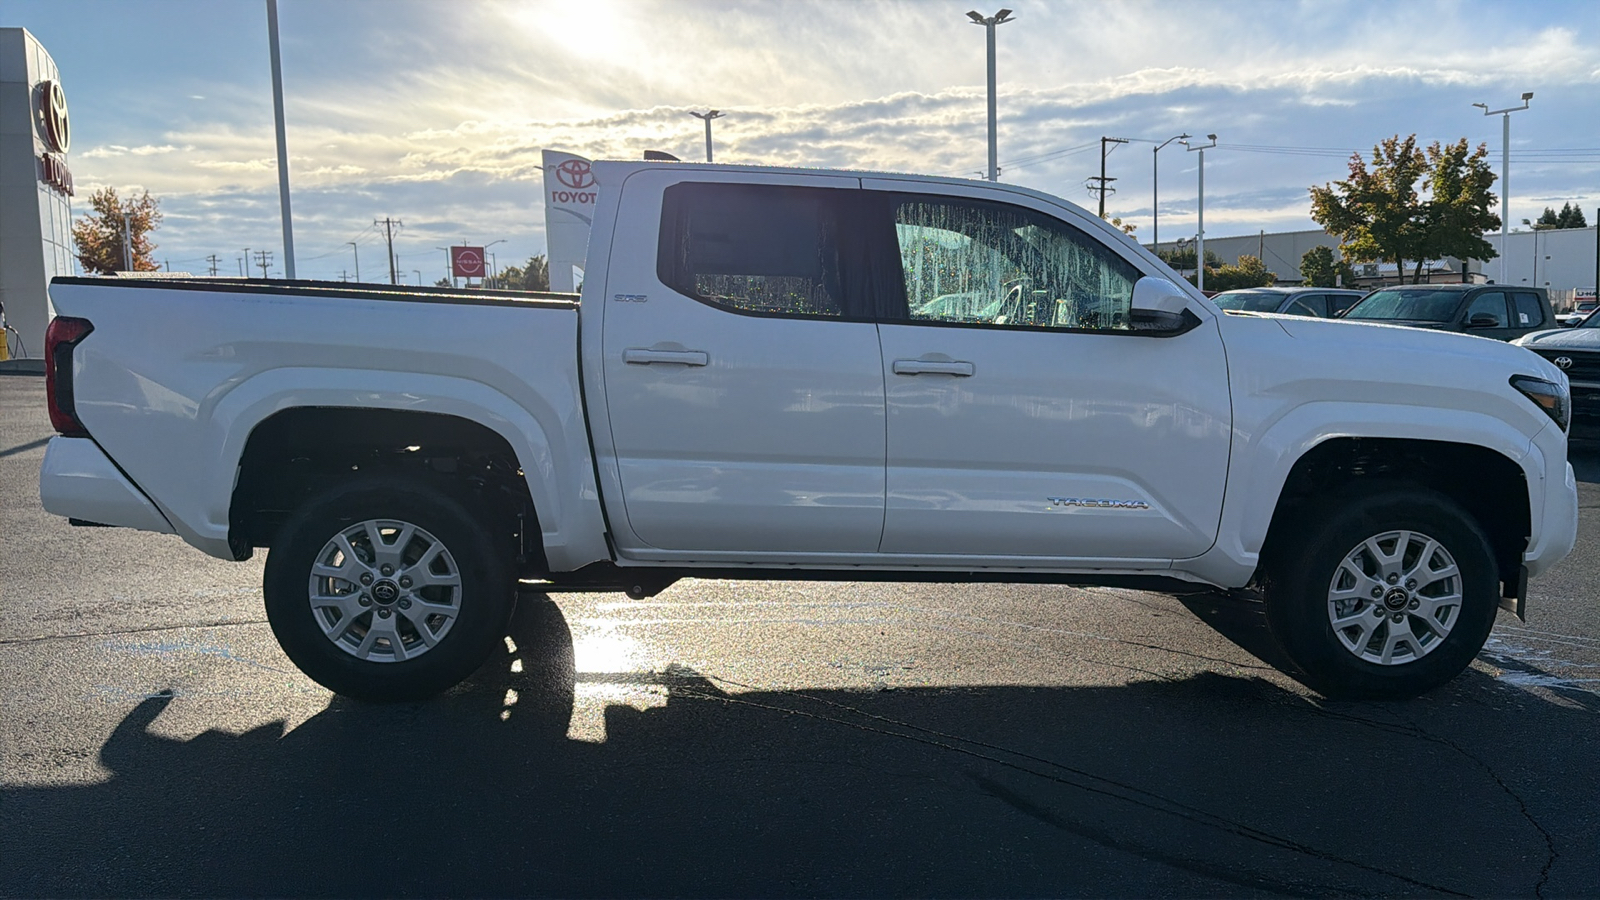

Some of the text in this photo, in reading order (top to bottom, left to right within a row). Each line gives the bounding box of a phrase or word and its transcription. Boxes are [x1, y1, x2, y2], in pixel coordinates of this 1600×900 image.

[41, 153, 74, 197] TOYO
[552, 191, 597, 204] TOYOT
[1047, 496, 1149, 509] TACOMA
